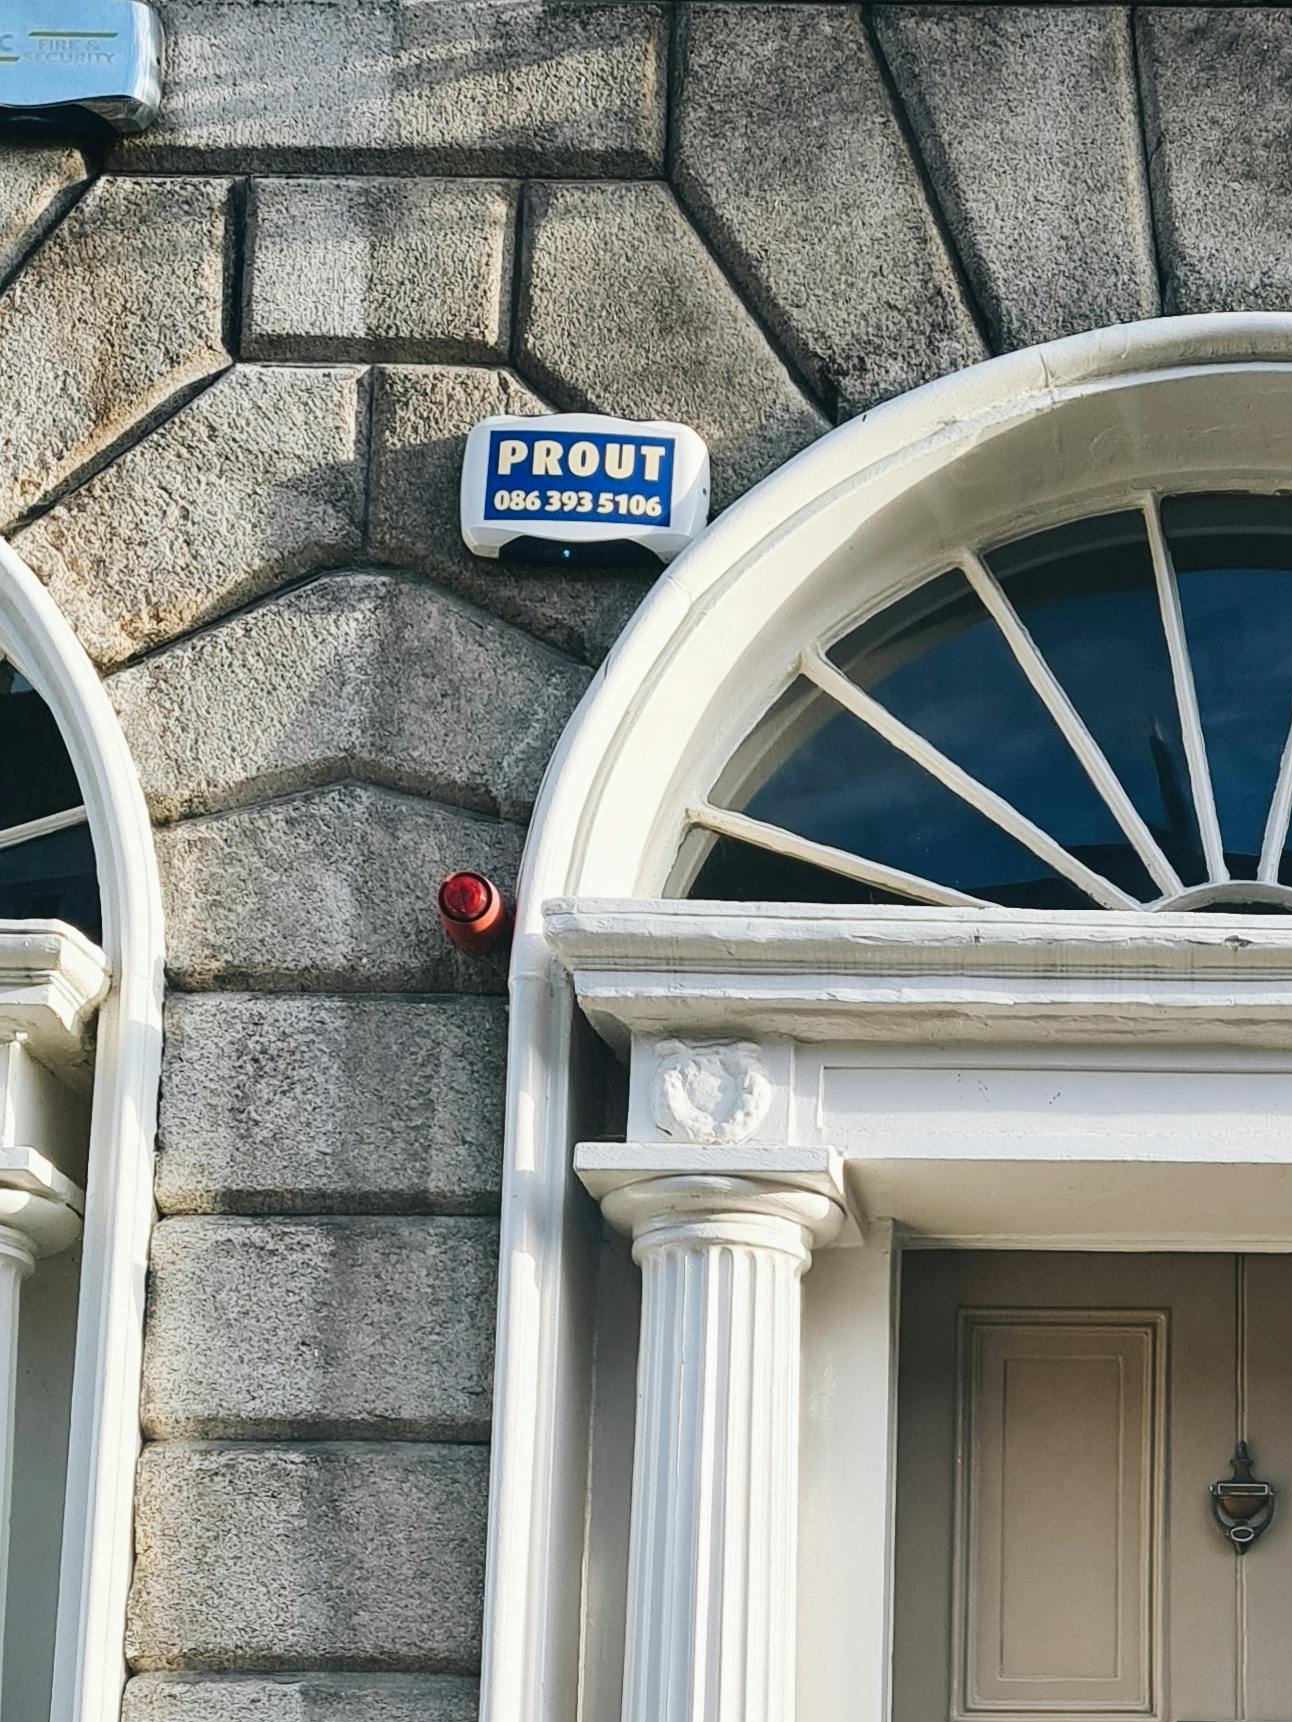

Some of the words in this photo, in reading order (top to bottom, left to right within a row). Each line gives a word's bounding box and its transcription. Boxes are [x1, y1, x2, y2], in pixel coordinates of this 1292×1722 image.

[38, 39, 81, 51] FIRE
[86, 39, 100, 51] &
[23, 51, 115, 64] SECURITY
[497, 439, 666, 481] PROUT
[494, 490, 541, 511] 086
[544, 490, 593, 513] 393
[597, 493, 662, 517] 5106
